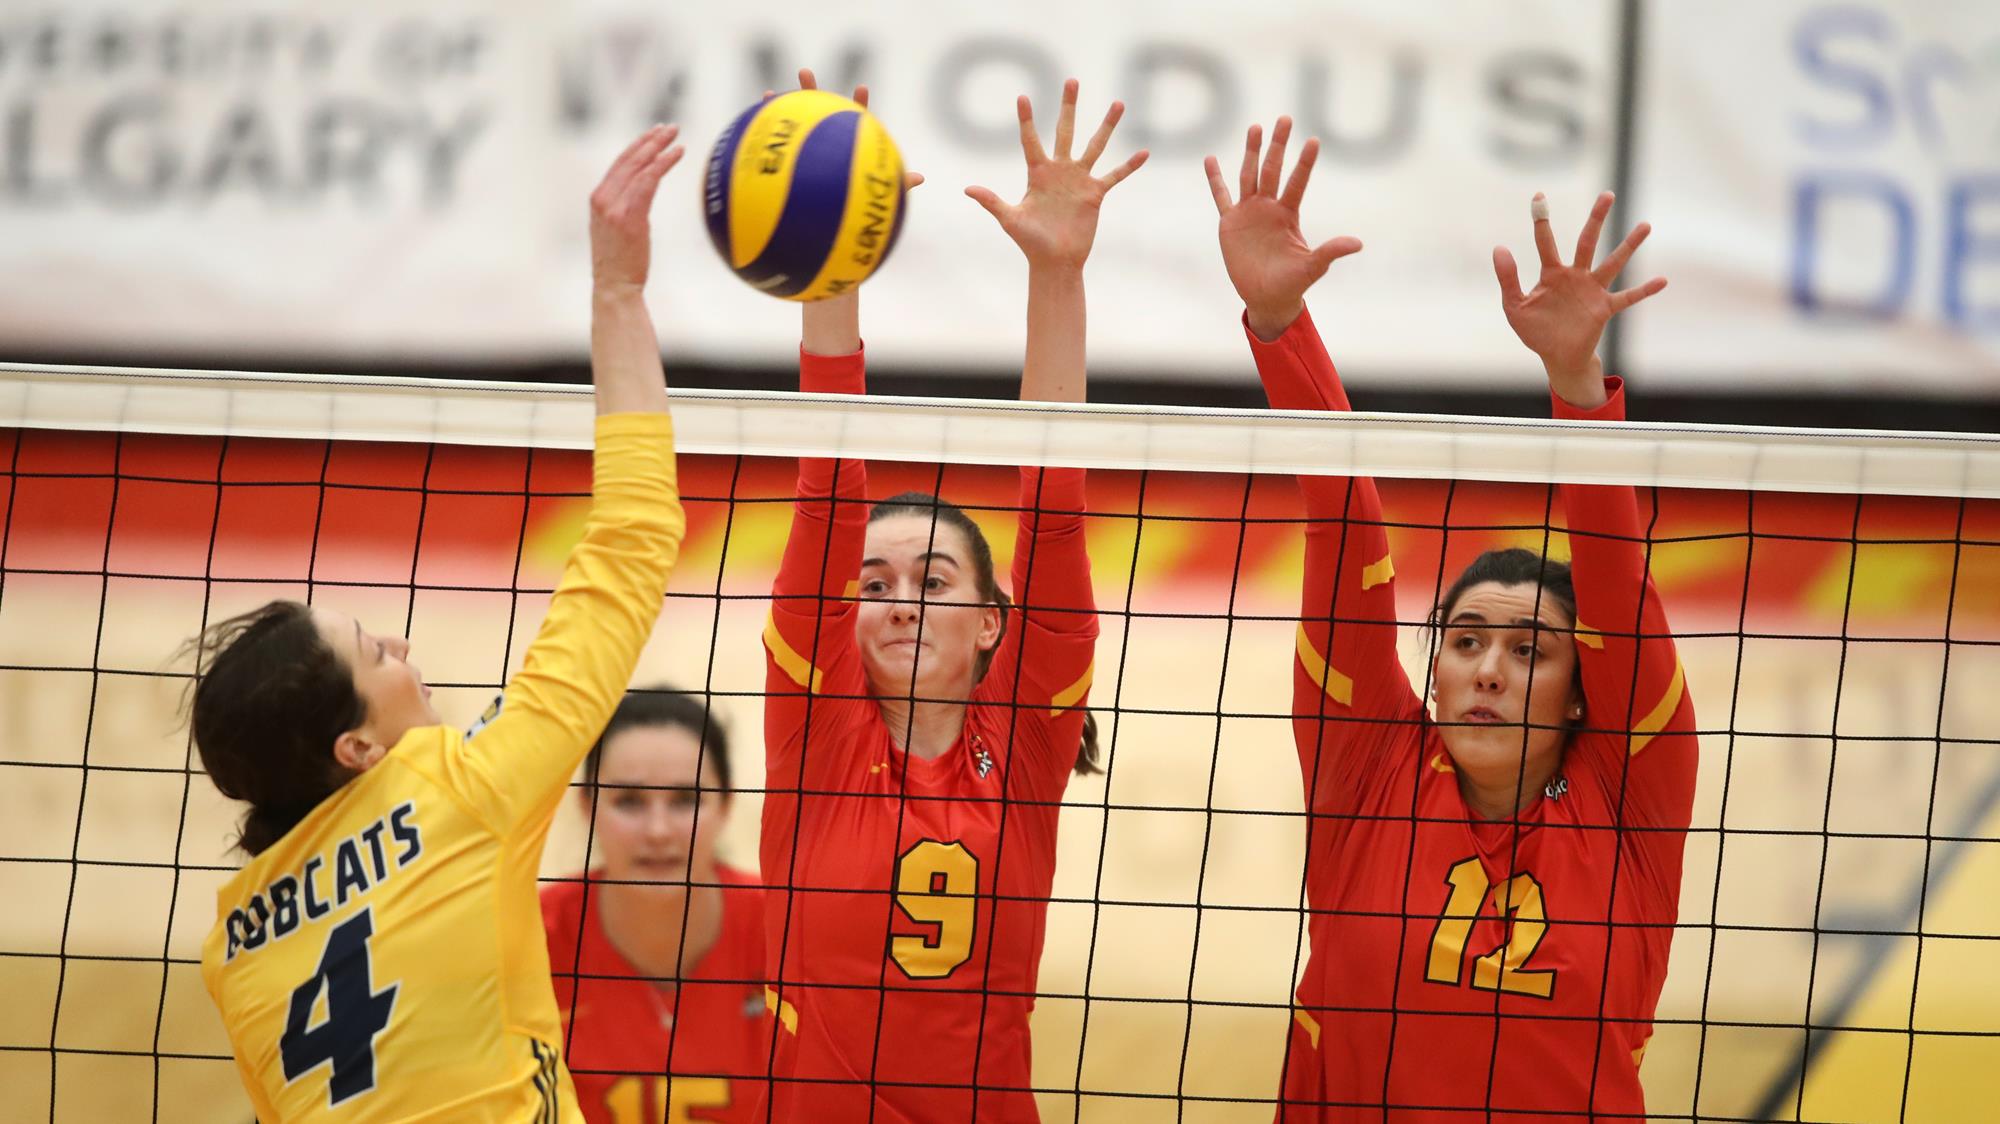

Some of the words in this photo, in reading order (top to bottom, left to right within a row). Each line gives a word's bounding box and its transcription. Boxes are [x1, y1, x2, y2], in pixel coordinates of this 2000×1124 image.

[224, 801, 422, 964] BOBCATS
[887, 837, 980, 980] 9
[1423, 854, 1557, 1001] 12
[279, 906, 400, 1110] 4
[604, 1074, 731, 1124] 15
